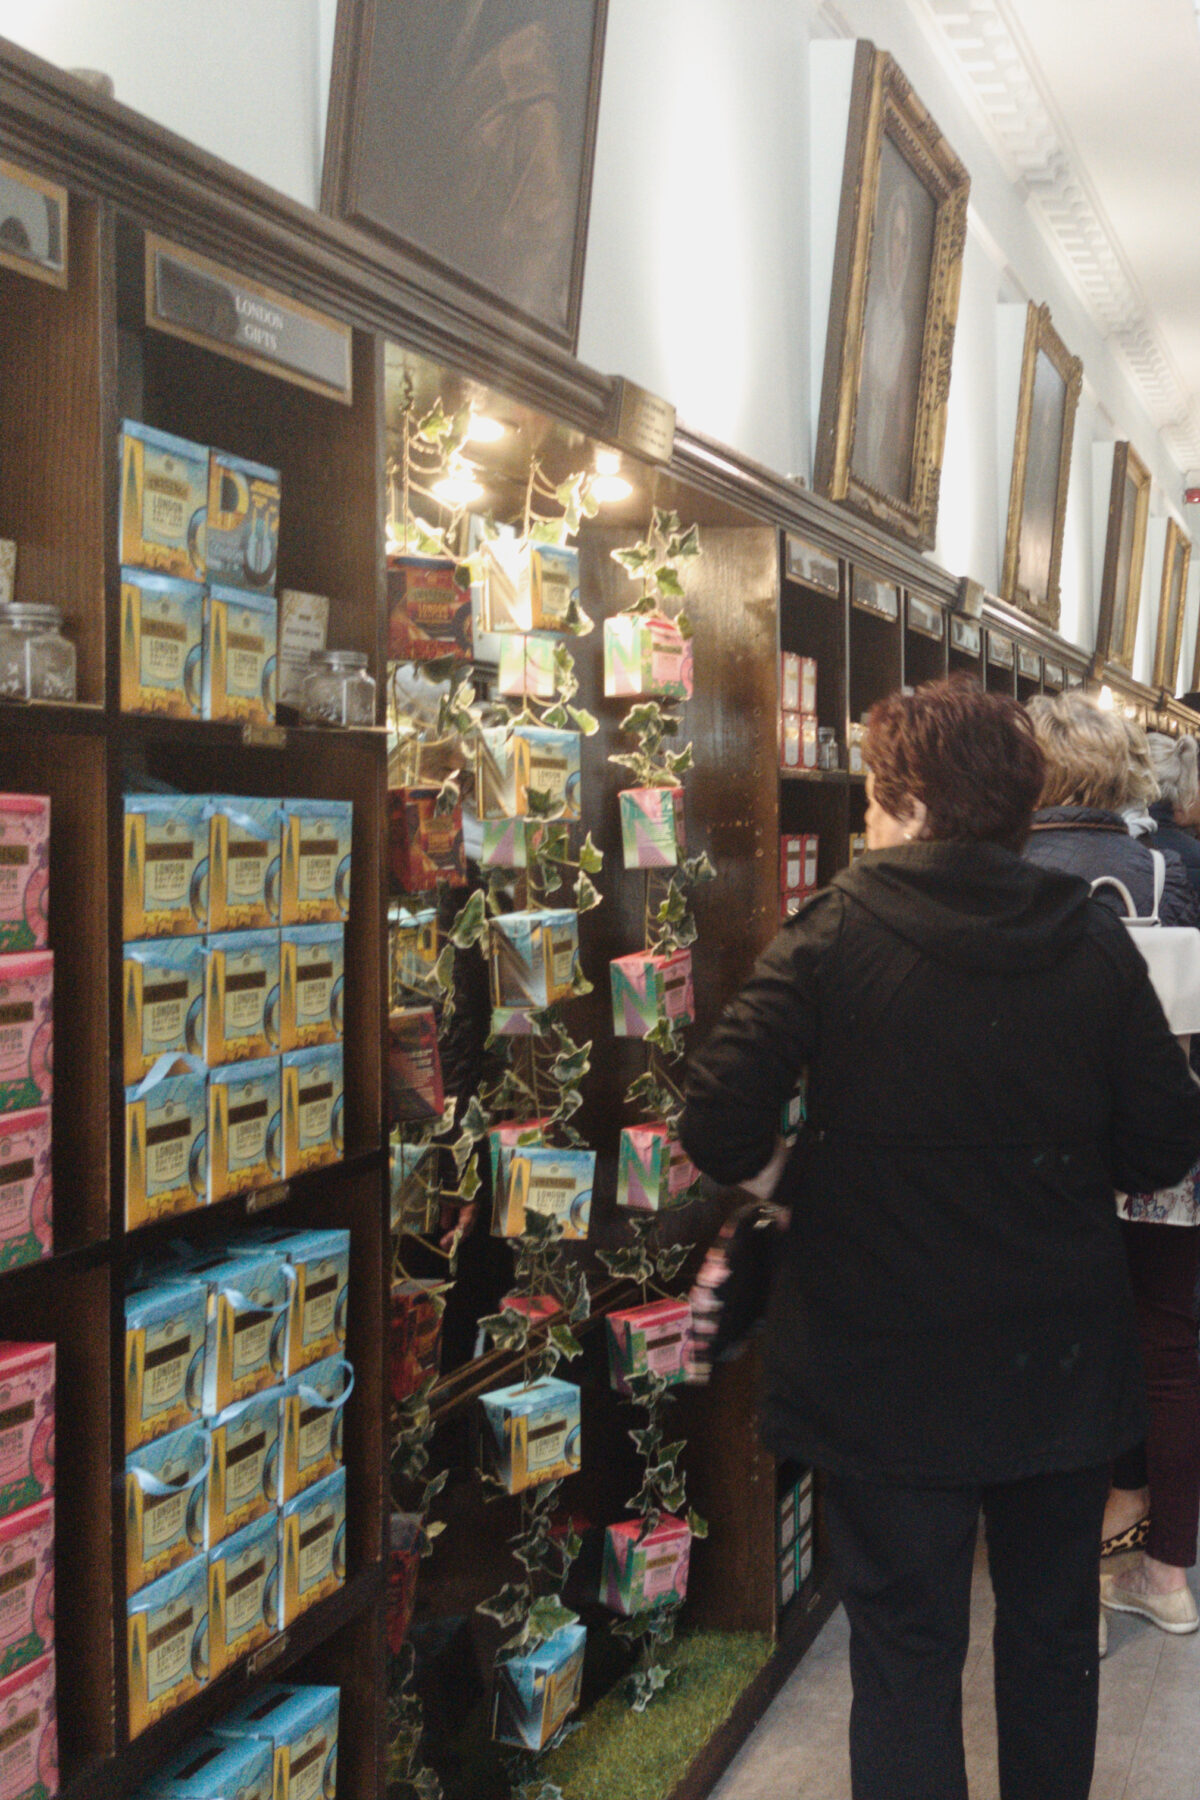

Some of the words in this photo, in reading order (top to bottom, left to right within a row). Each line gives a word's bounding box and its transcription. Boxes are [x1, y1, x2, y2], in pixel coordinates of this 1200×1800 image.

[235, 295, 284, 330] LONDON
[244, 323, 277, 351] GIFTS
[155, 861, 184, 873] LONDON
[155, 1140, 183, 1157] LONDON
[156, 1634, 185, 1660] LONDON
